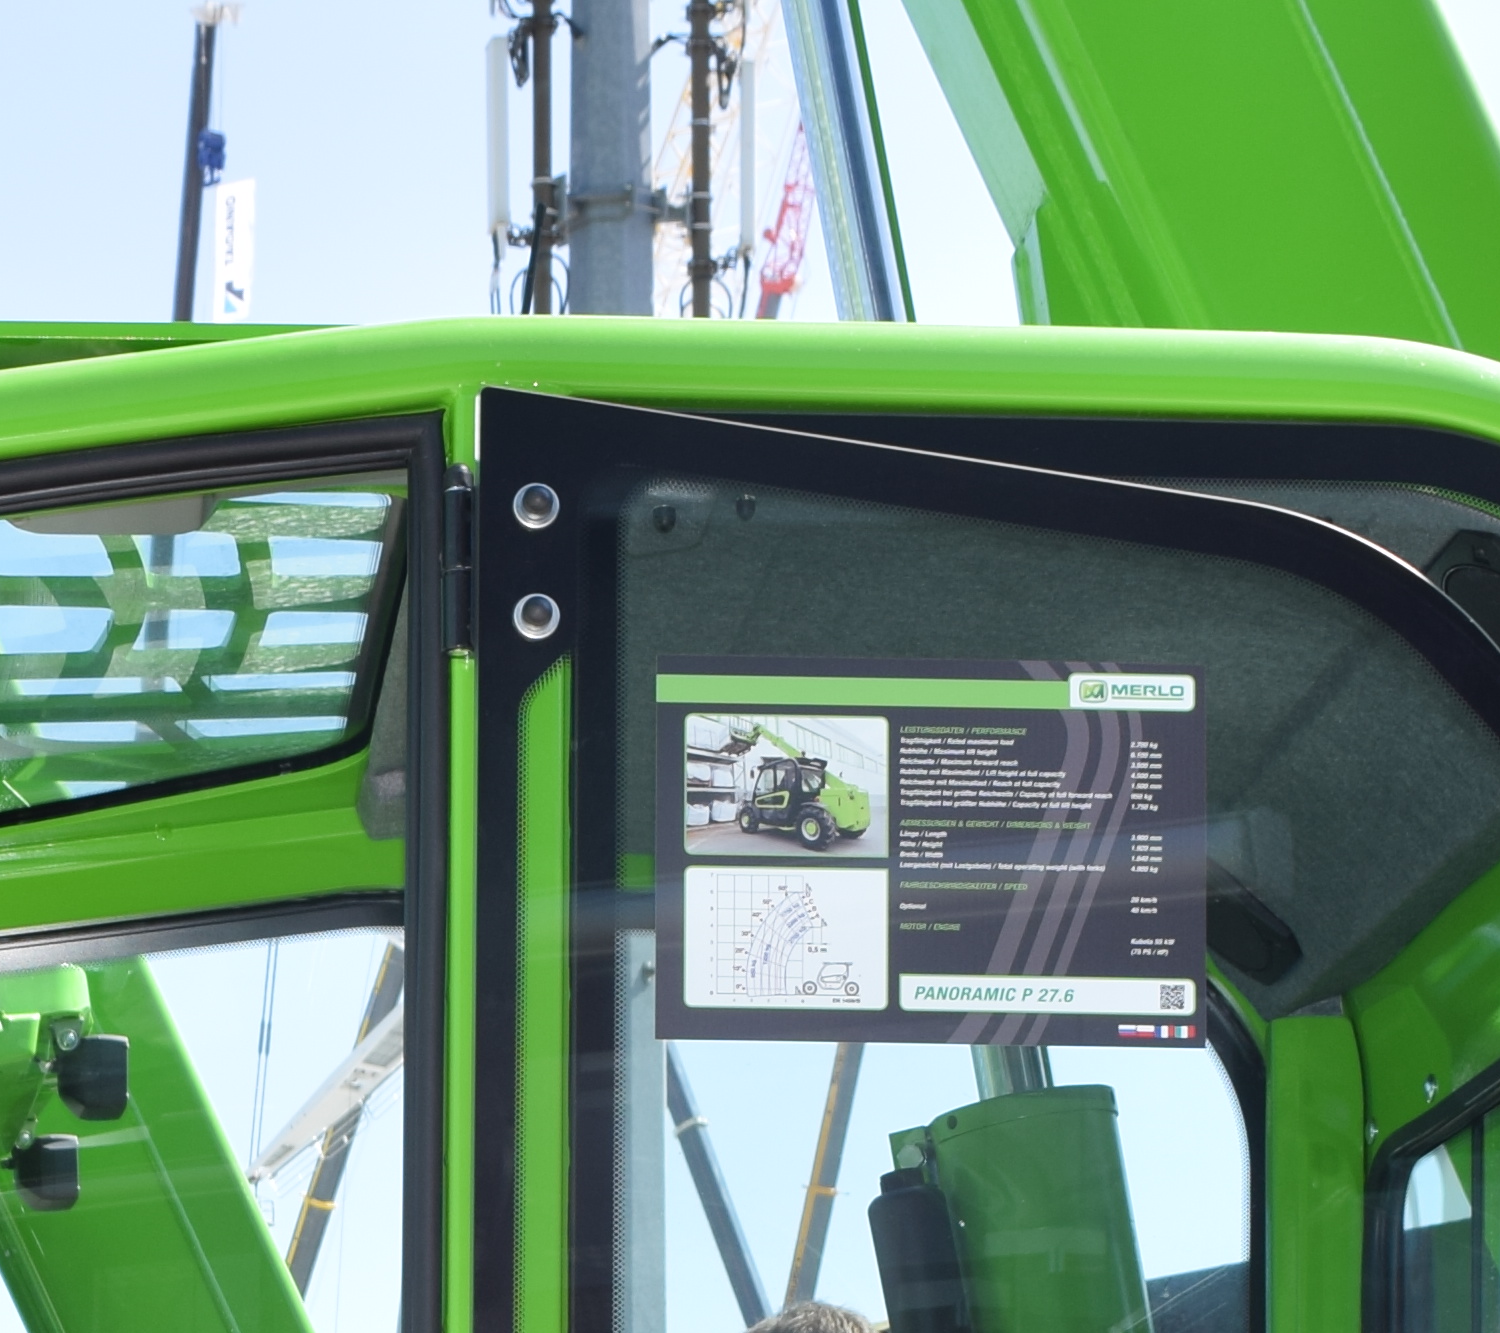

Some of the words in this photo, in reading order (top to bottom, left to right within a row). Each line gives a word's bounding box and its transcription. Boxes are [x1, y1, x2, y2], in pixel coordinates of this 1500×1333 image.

[1111, 684, 1184, 697] MERLO
[914, 986, 1016, 1003] PANORAMIC
[1021, 987, 1033, 1003] P
[1037, 987, 1074, 1004] 27.6
